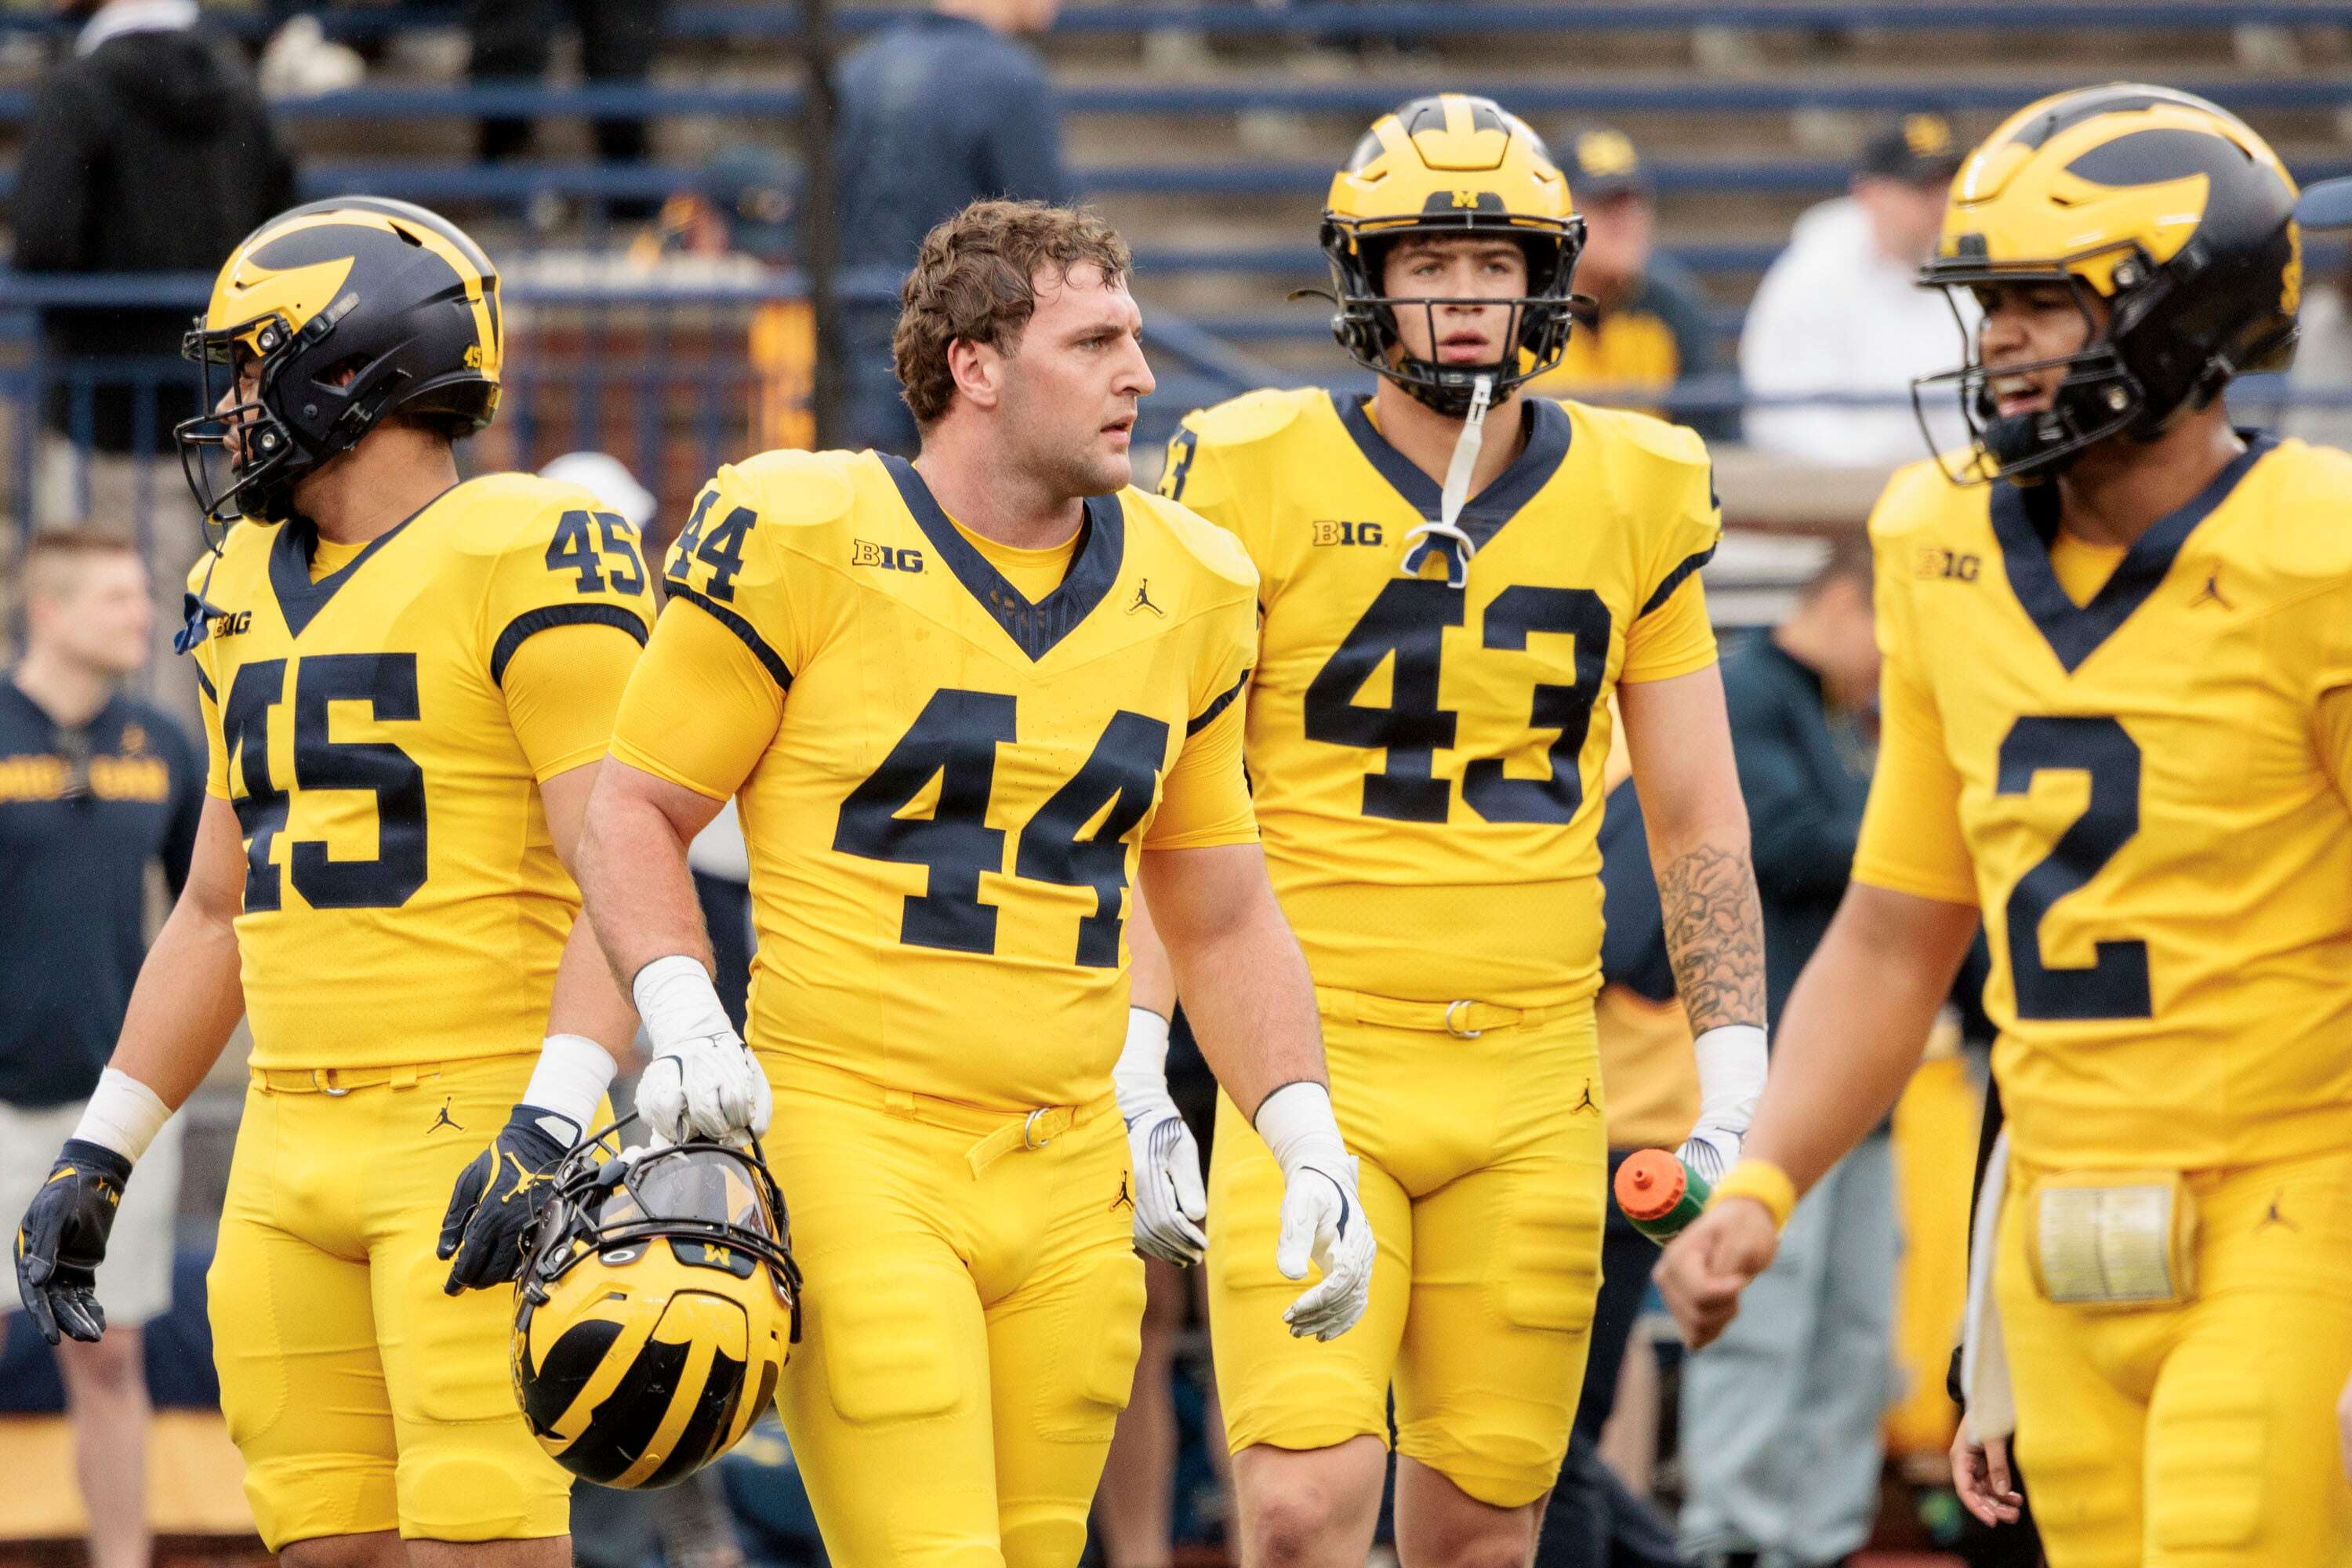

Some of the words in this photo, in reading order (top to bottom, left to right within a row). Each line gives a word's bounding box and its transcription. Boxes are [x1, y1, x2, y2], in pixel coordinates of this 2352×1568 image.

[1452, 190, 1479, 209] M
[464, 345, 482, 368] 45
[545, 510, 644, 597] 45
[668, 490, 758, 603] 44
[223, 652, 427, 913] 45
[1304, 578, 1612, 825] 43
[832, 688, 1170, 968] 44
[1995, 716, 2154, 1019] 2
